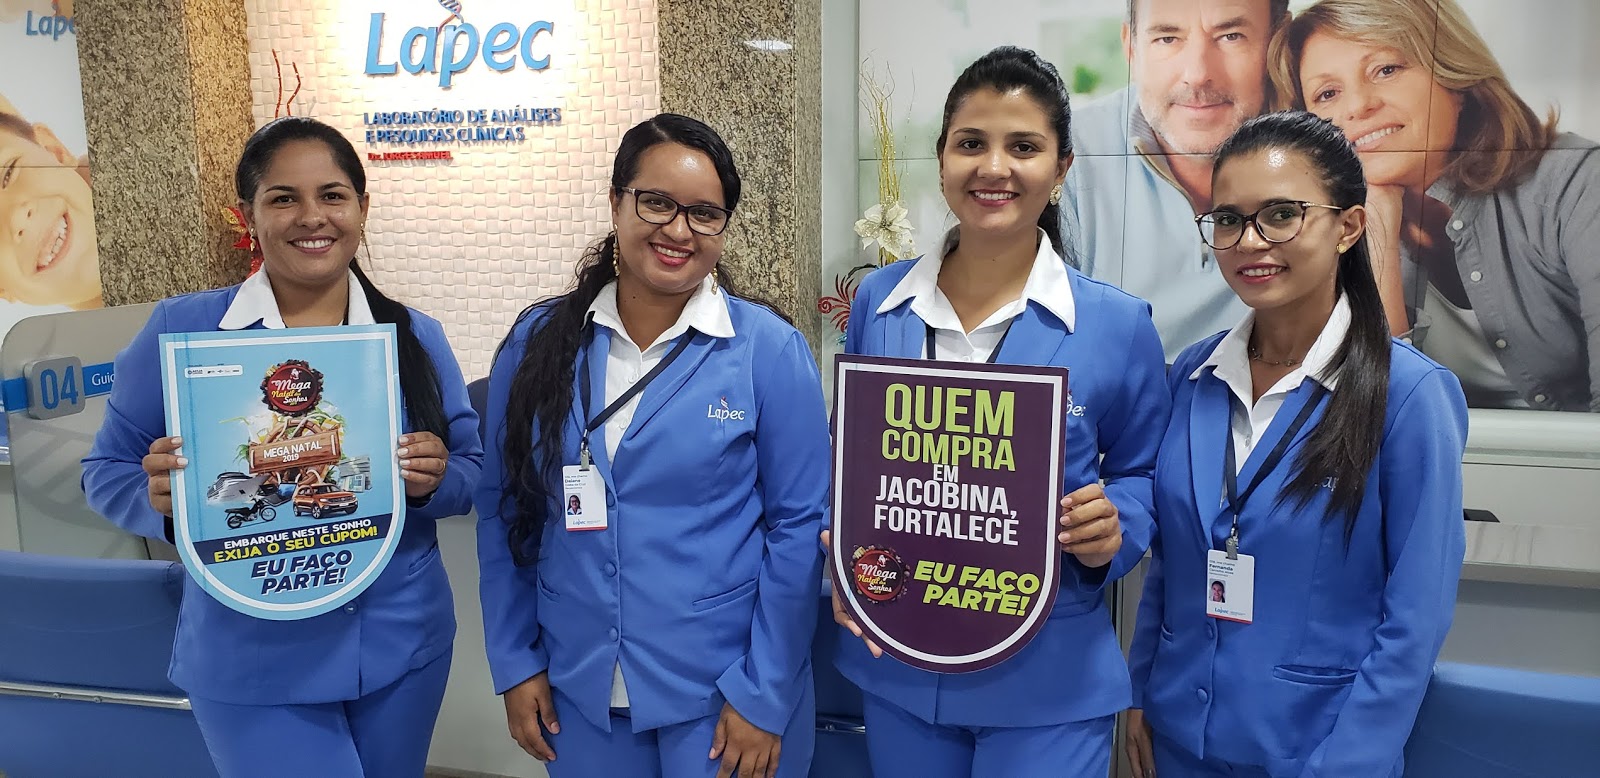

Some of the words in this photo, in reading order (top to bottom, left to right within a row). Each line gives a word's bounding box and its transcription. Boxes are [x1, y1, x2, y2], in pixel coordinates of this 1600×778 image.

[364, 12, 554, 88] Lapec
[364, 107, 465, 126] LABORATÓRIO
[467, 109, 488, 124] DE
[491, 104, 562, 123] ANÁLISES
[366, 131, 375, 143] E
[377, 128, 455, 144] PESQUISAS
[456, 126, 525, 142] CLÍNICAS
[41, 365, 79, 410] 04
[271, 379, 311, 393] Mega
[272, 389, 296, 399] Natal
[283, 396, 308, 404] Sonhos
[885, 383, 1015, 437] QUEM
[707, 404, 746, 423] Lapec
[263, 447, 290, 459] MEGA
[291, 440, 322, 453] NATAL
[282, 453, 300, 462] 2019
[882, 428, 1016, 471] COMPRA
[933, 464, 959, 483] EM
[875, 475, 1018, 520] JACOBINA,
[224, 534, 290, 550] EMBARQUE
[292, 525, 330, 540] NESTE
[332, 518, 372, 532] SONHO
[874, 504, 1019, 546] FORTALECE
[214, 546, 262, 563] EXIJA
[267, 542, 280, 554] O
[285, 536, 315, 551] SEU
[320, 526, 378, 545] CUPOM!
[251, 558, 286, 579] EU
[290, 549, 354, 573] FAÇO
[858, 563, 897, 581] Mega
[261, 567, 348, 596] PARTE!
[857, 574, 881, 585] Natal
[867, 583, 892, 592] Sonhos
[913, 560, 956, 584] EU
[958, 565, 1040, 595] FAÇO
[922, 583, 1031, 617] PARTE!
